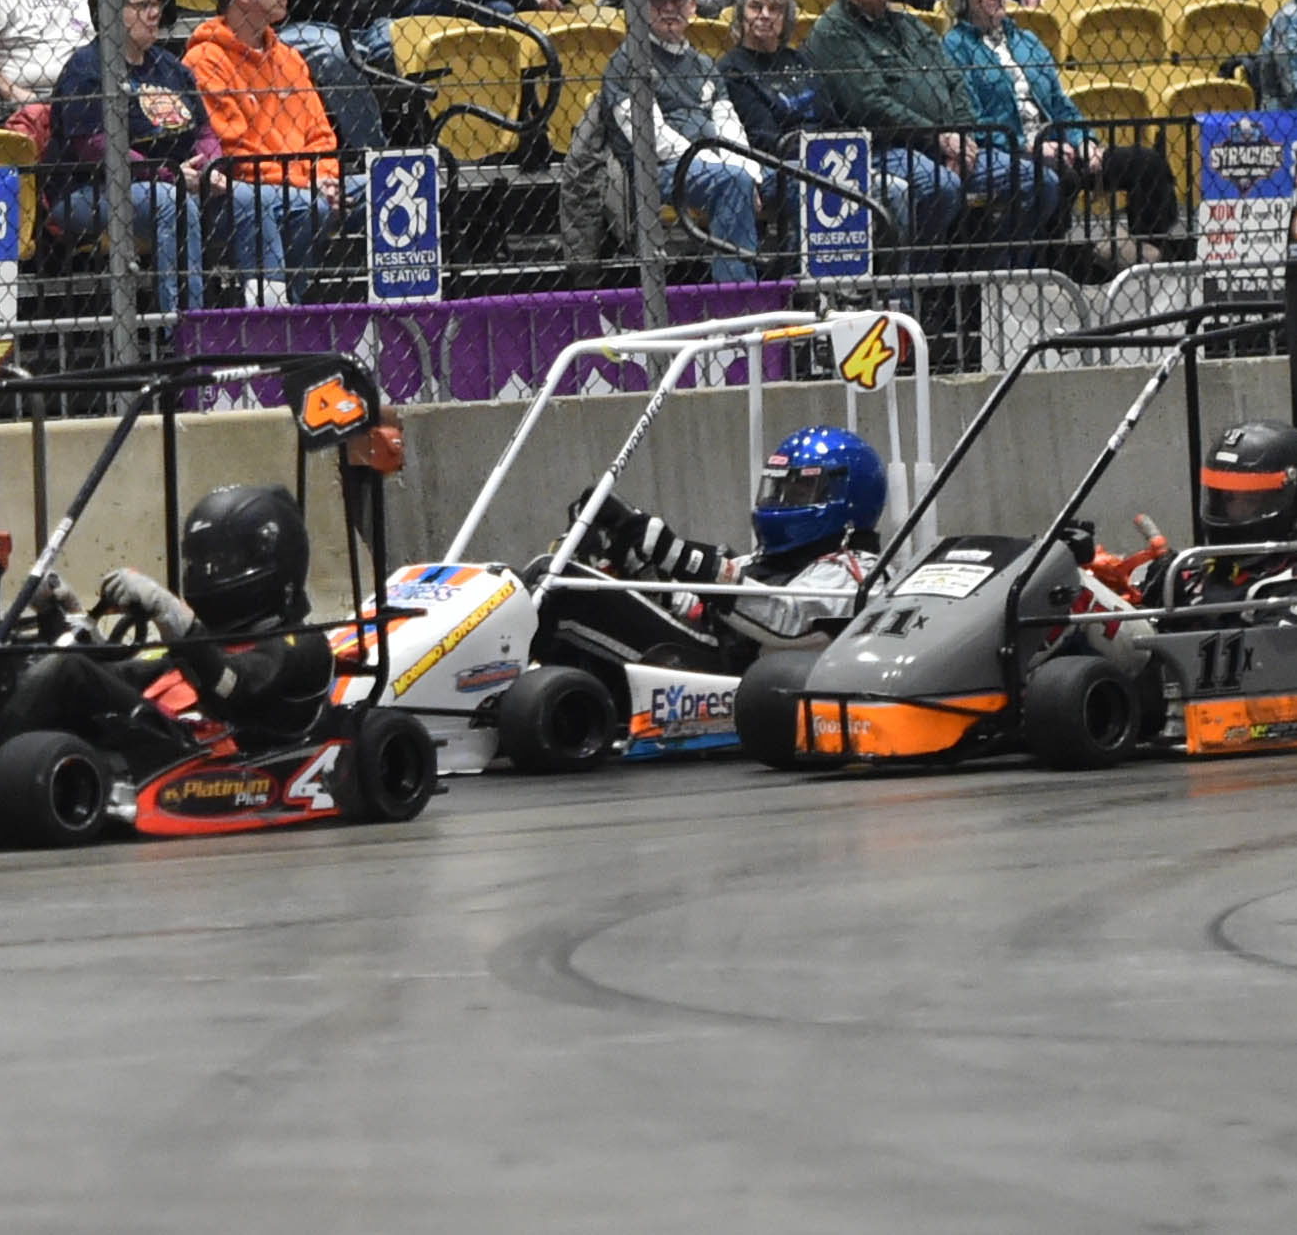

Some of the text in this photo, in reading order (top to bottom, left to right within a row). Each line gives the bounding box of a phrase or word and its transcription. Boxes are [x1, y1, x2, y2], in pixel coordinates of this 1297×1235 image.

[809, 231, 867, 246] RESERVED
[375, 250, 436, 266] RESERVED
[381, 268, 431, 283] SEATING
[840, 316, 894, 390] 4
[288, 744, 342, 810] 4
[182, 778, 270, 800] Platinum
